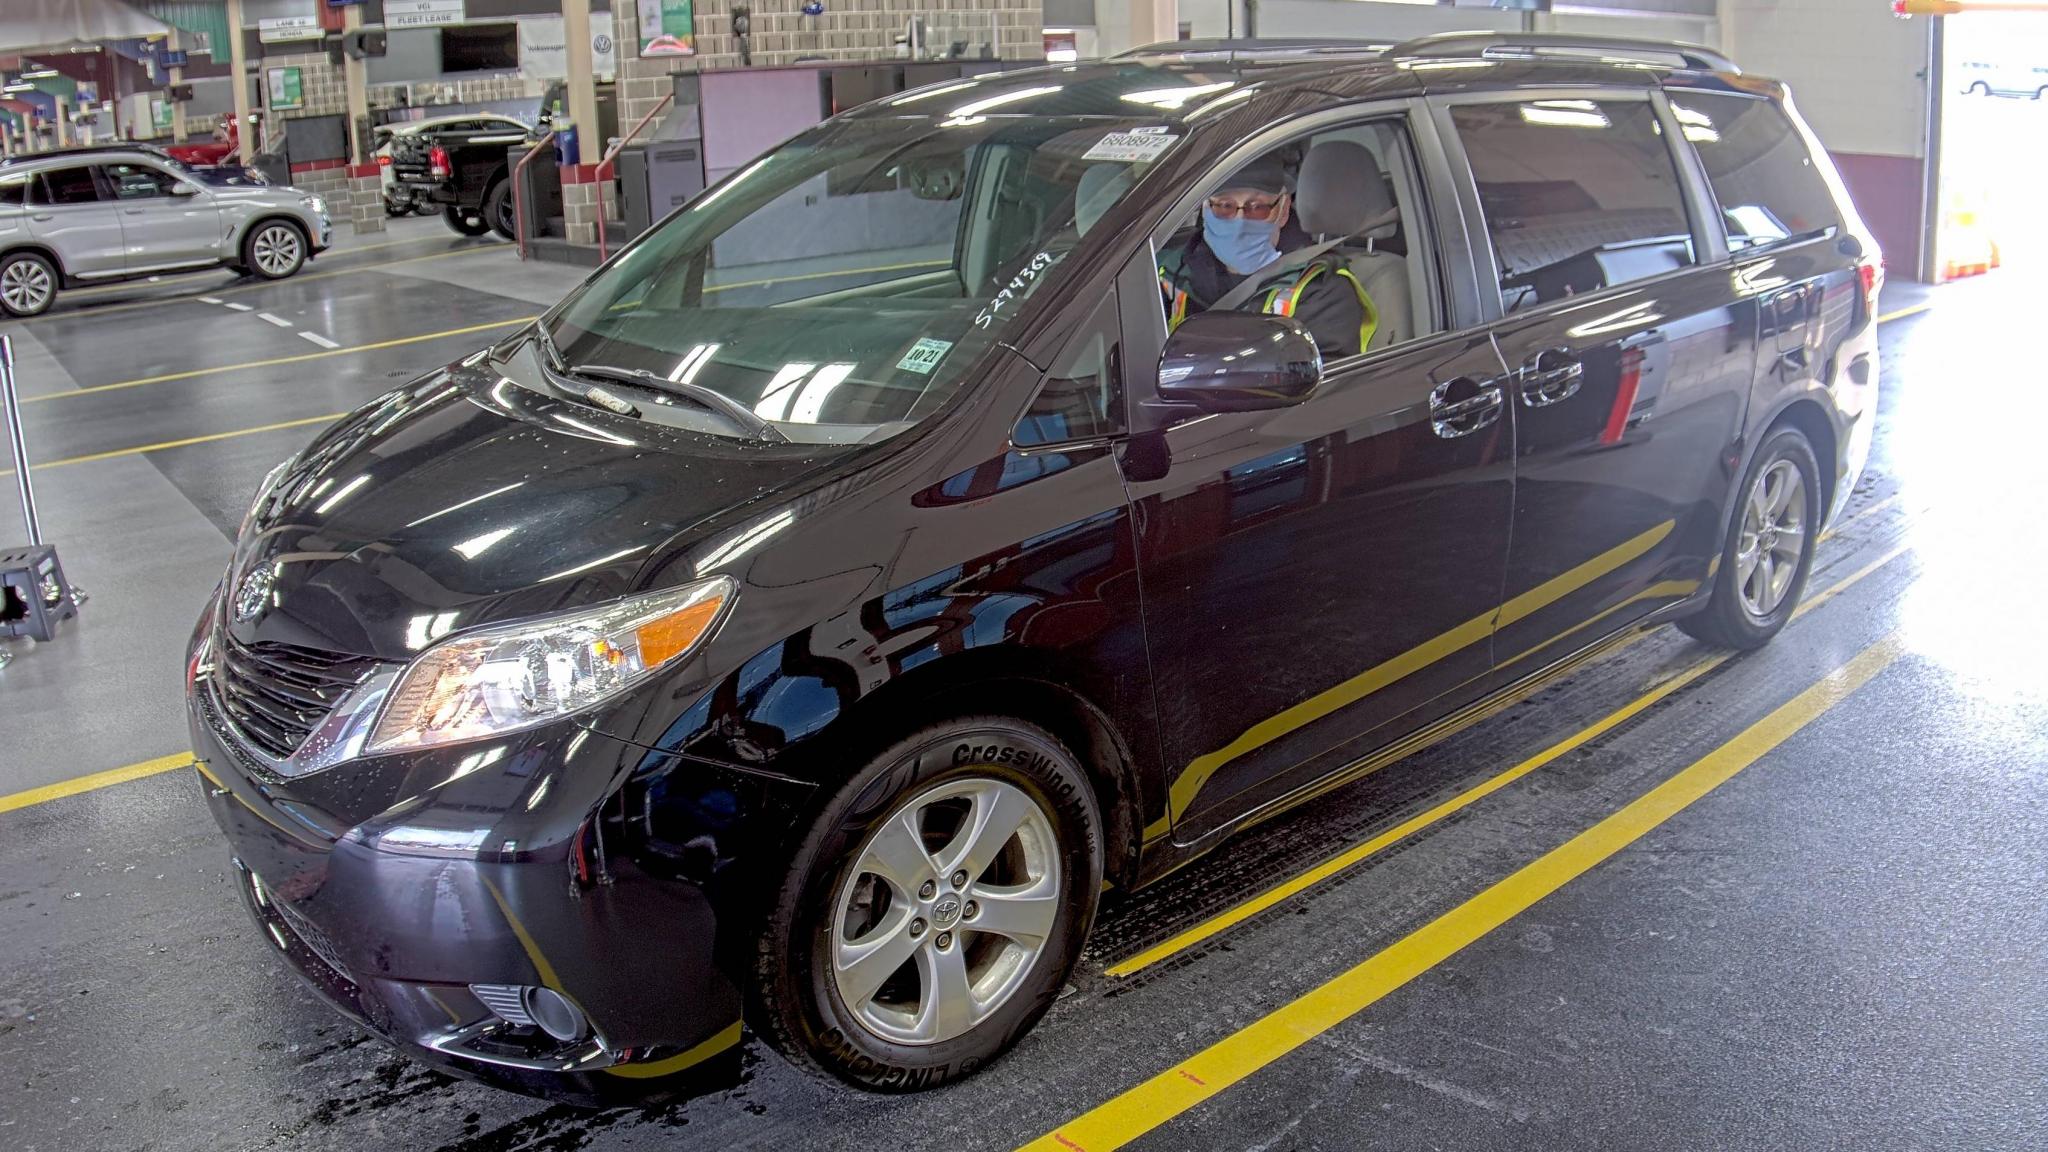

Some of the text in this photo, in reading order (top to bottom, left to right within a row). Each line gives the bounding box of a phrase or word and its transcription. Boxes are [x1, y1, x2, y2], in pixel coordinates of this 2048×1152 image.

[397, 14, 452, 24] FLEET LEASE
[1101, 133, 1169, 149] 6808972
[908, 349, 940, 363] 10 21
[952, 743, 1076, 798] CrossWind
